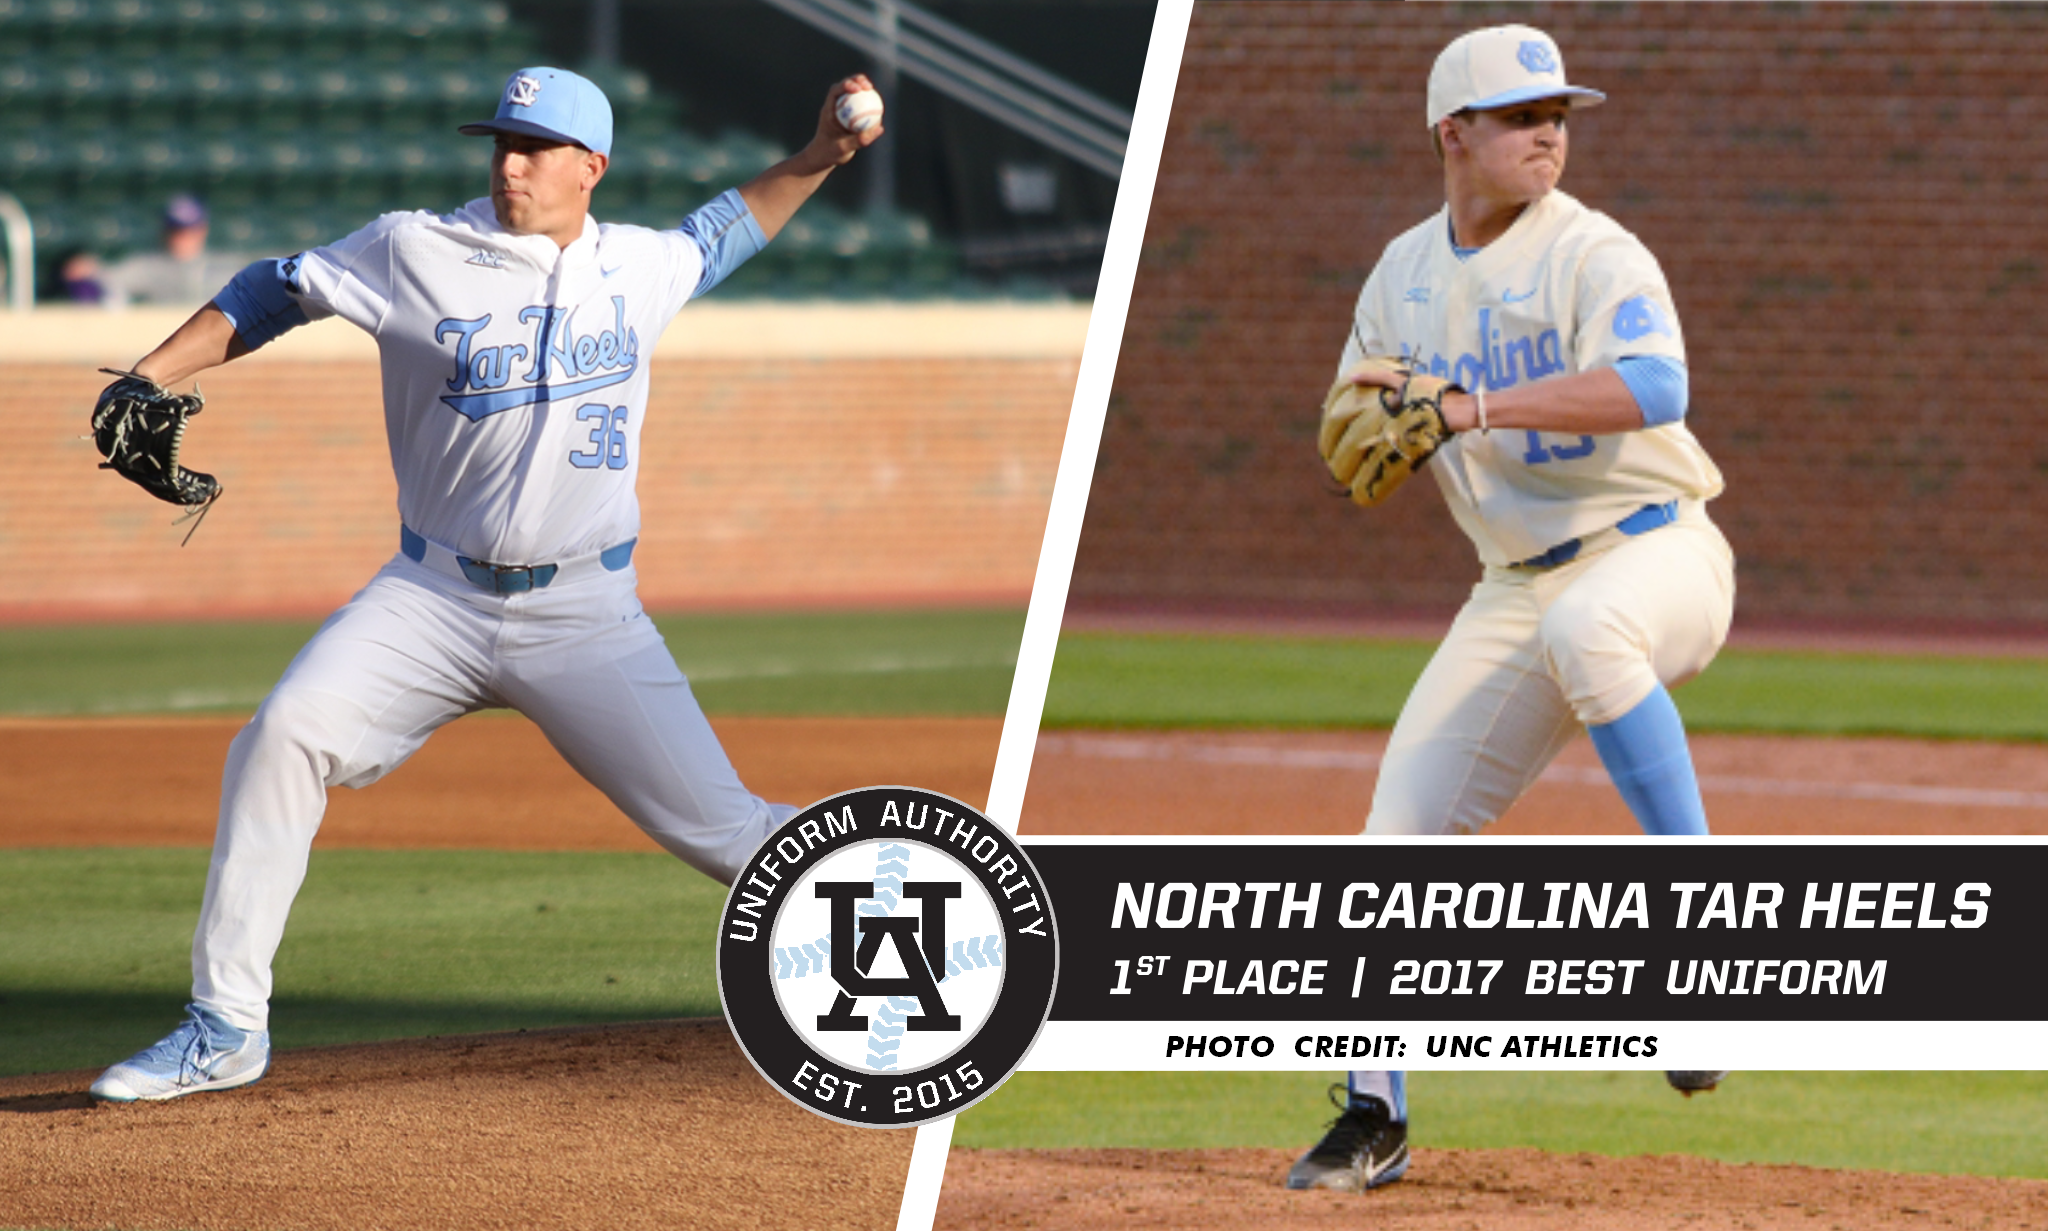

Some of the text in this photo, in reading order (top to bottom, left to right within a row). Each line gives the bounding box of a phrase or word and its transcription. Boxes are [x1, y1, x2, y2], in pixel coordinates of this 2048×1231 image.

[435, 295, 639, 392] Tar Heels
[1400, 308, 1566, 393] rolina
[569, 403, 628, 470] 36
